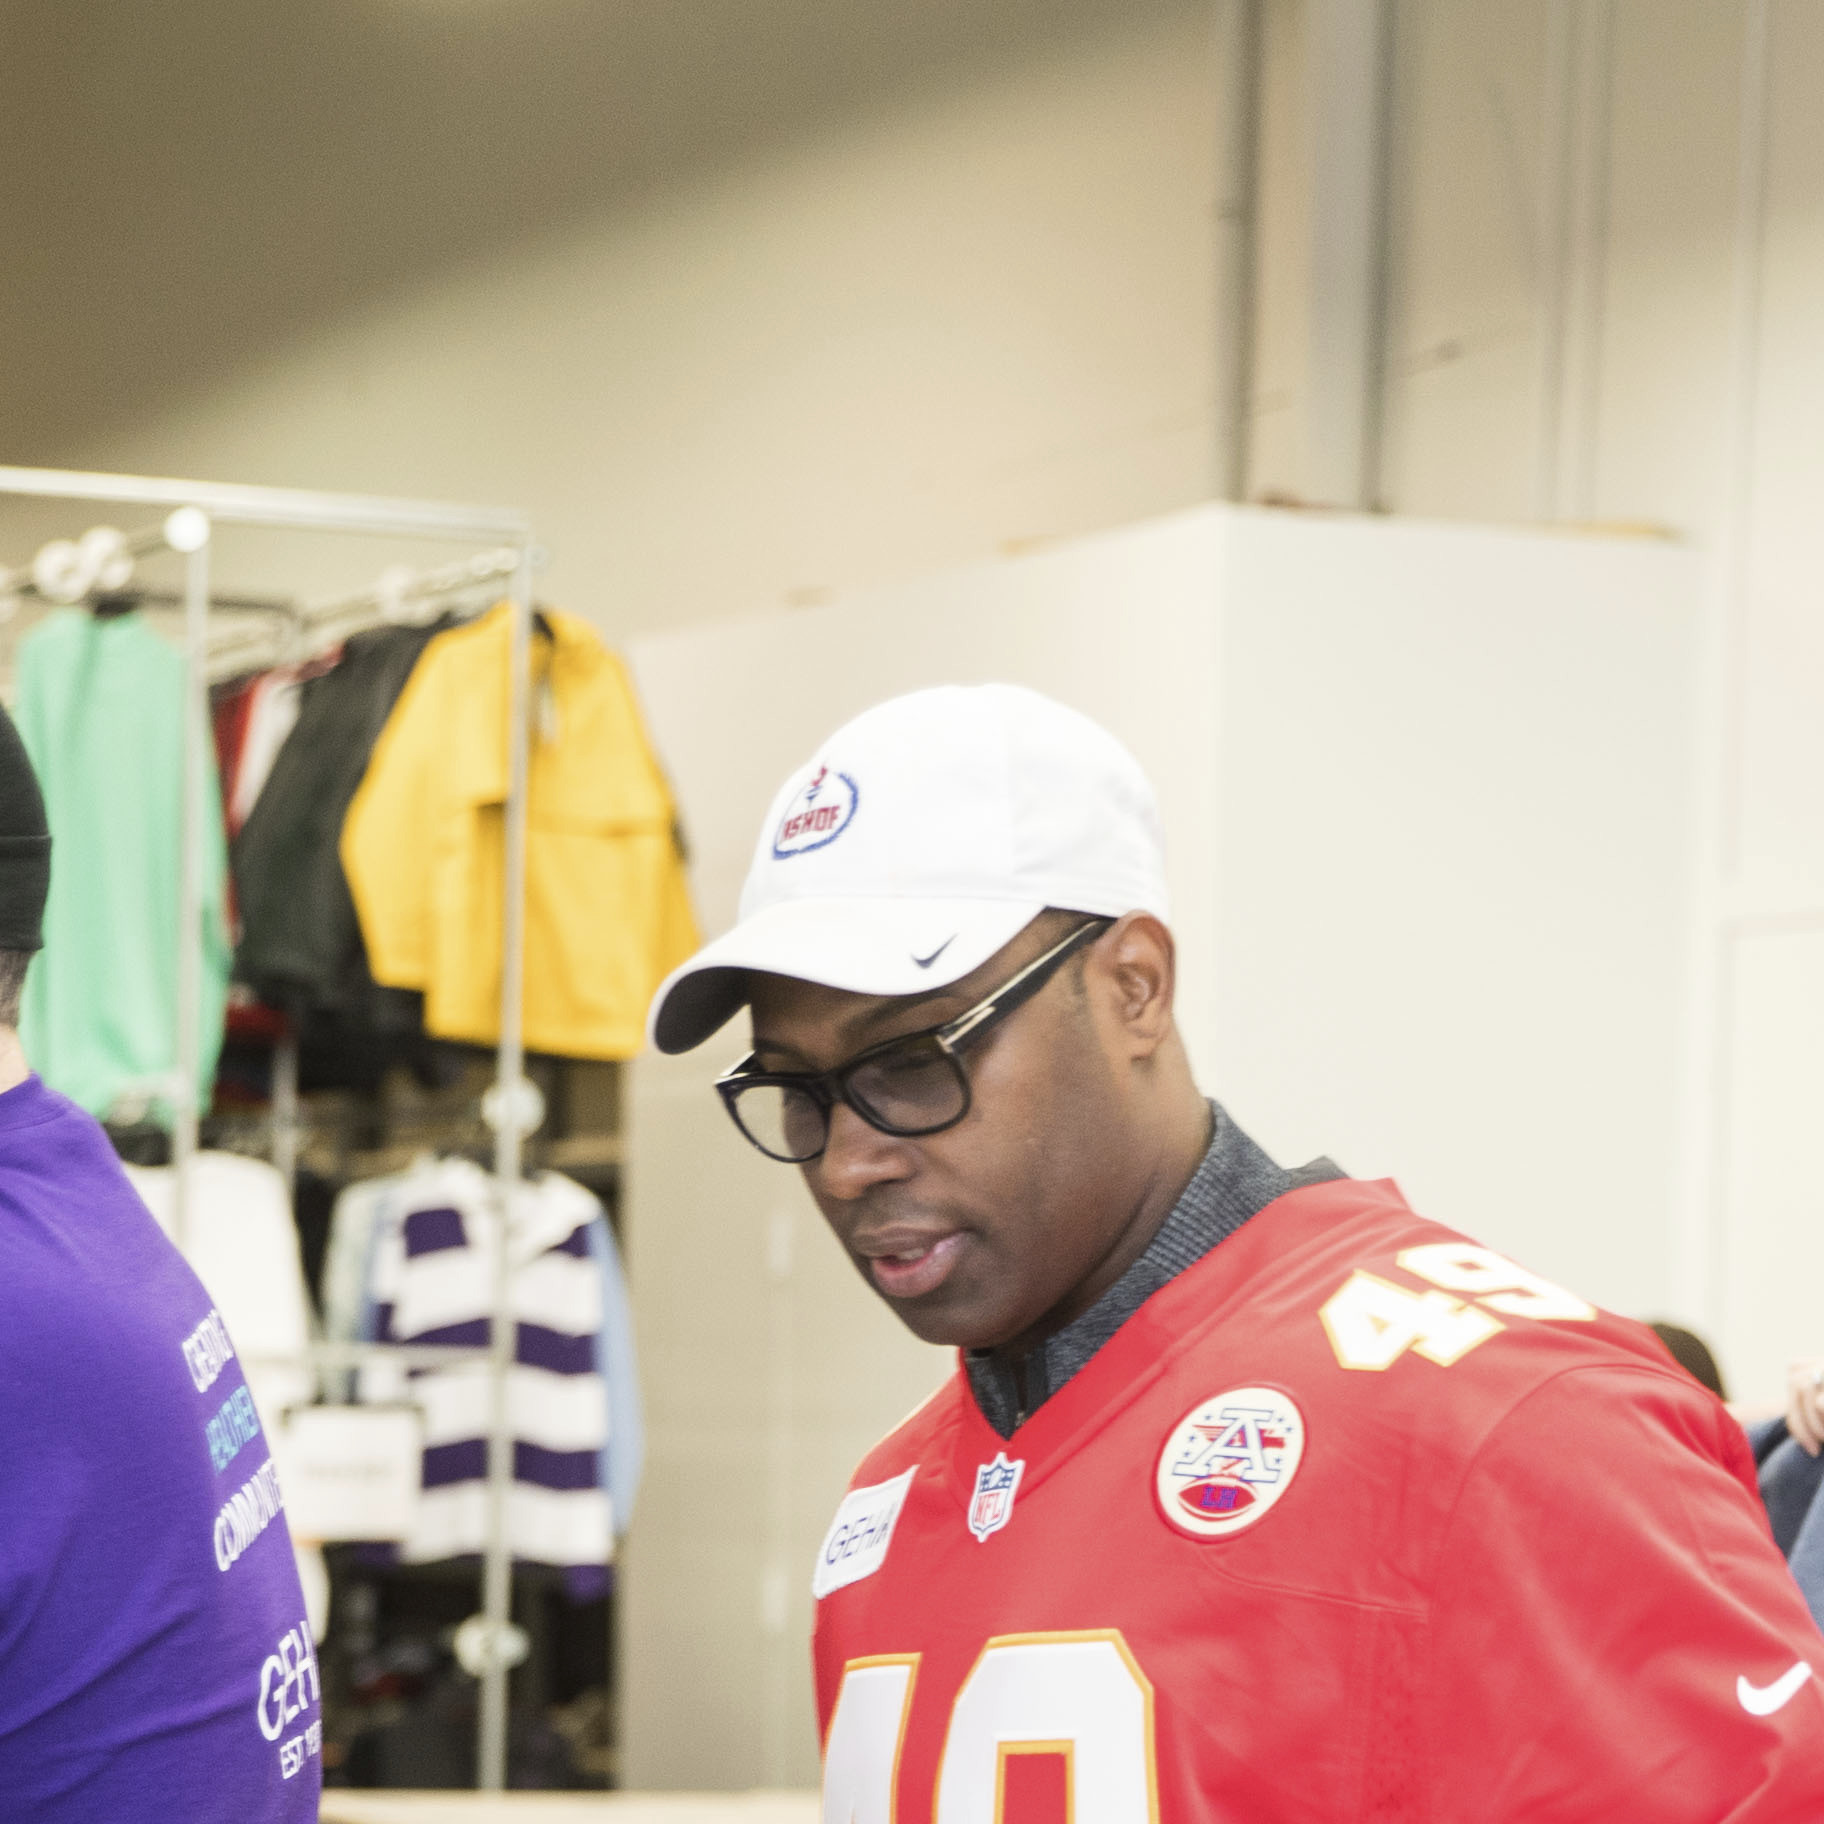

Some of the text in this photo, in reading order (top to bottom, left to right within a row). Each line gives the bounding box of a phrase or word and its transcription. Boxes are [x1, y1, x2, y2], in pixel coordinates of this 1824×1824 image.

[1317, 1242, 1598, 1372] 49
[976, 1492, 1002, 1525] NFL
[1201, 1486, 1239, 1509] LH
[257, 1620, 320, 1741] GEH
